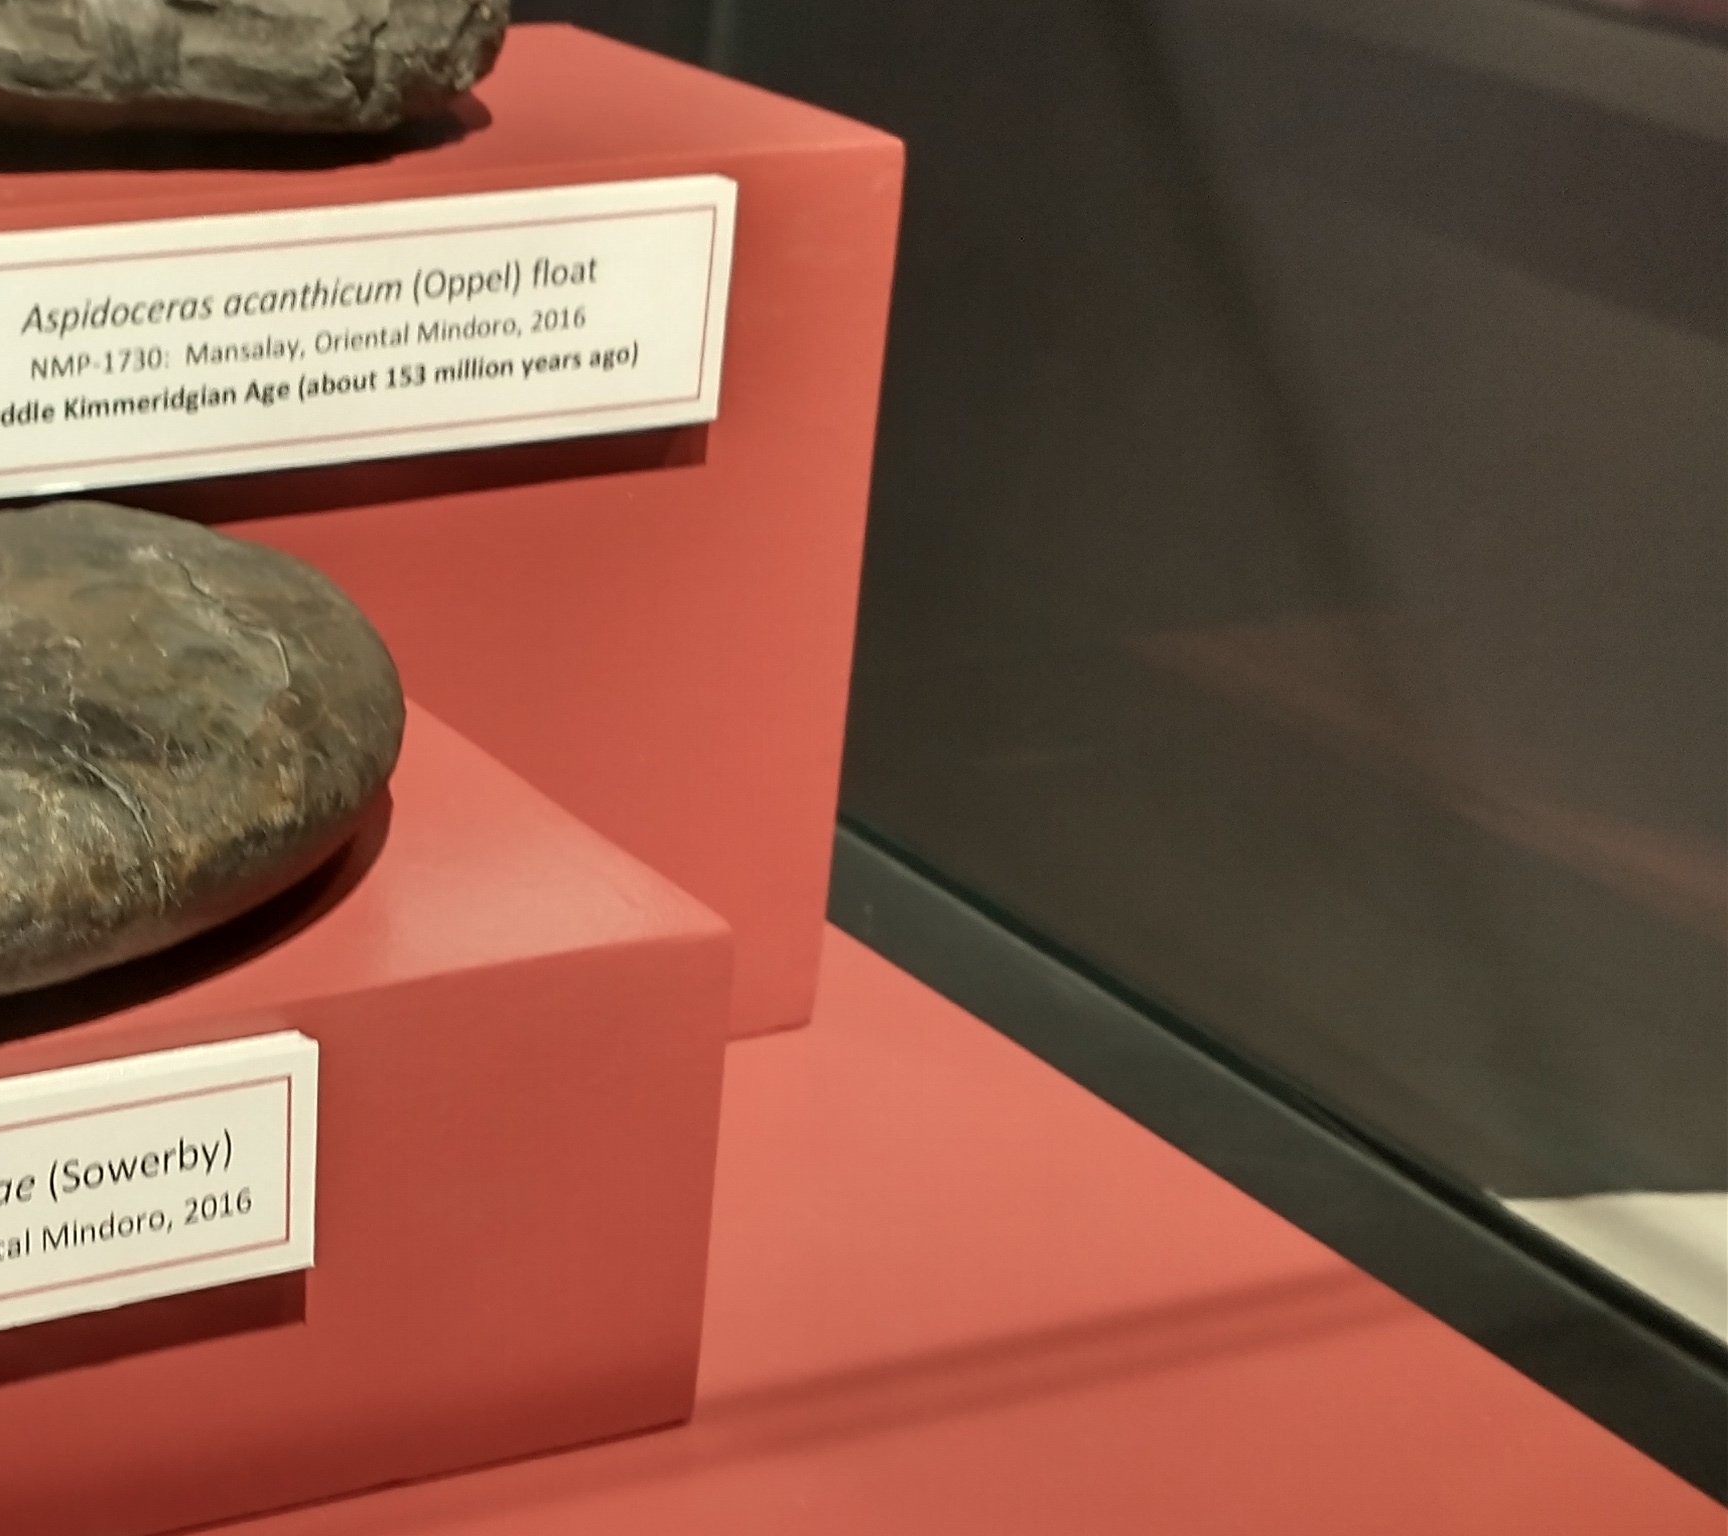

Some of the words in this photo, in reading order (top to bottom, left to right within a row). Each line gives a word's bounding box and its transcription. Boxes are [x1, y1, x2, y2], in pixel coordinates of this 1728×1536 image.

[19, 295, 215, 342] Aspidoceras
[222, 276, 404, 319] acanthicum
[411, 258, 523, 308] (Oppel)
[531, 256, 599, 290] float
[29, 345, 170, 382] NMP-1730:
[184, 333, 307, 367] Mansalay,
[313, 320, 412, 356] Oriental
[416, 313, 523, 346] Mindoro,
[529, 305, 588, 334] 2016
[62, 382, 239, 423] Kimmeridgian
[242, 377, 292, 409] Age
[296, 368, 379, 405] (about
[386, 361, 428, 391] 153
[432, 354, 515, 385] million
[520, 351, 583, 382] years
[587, 338, 640, 373] ago)
[47, 1126, 233, 1206] (Sowerby)
[40, 1208, 174, 1254] Mindoro,
[183, 1185, 254, 1227] 2016
